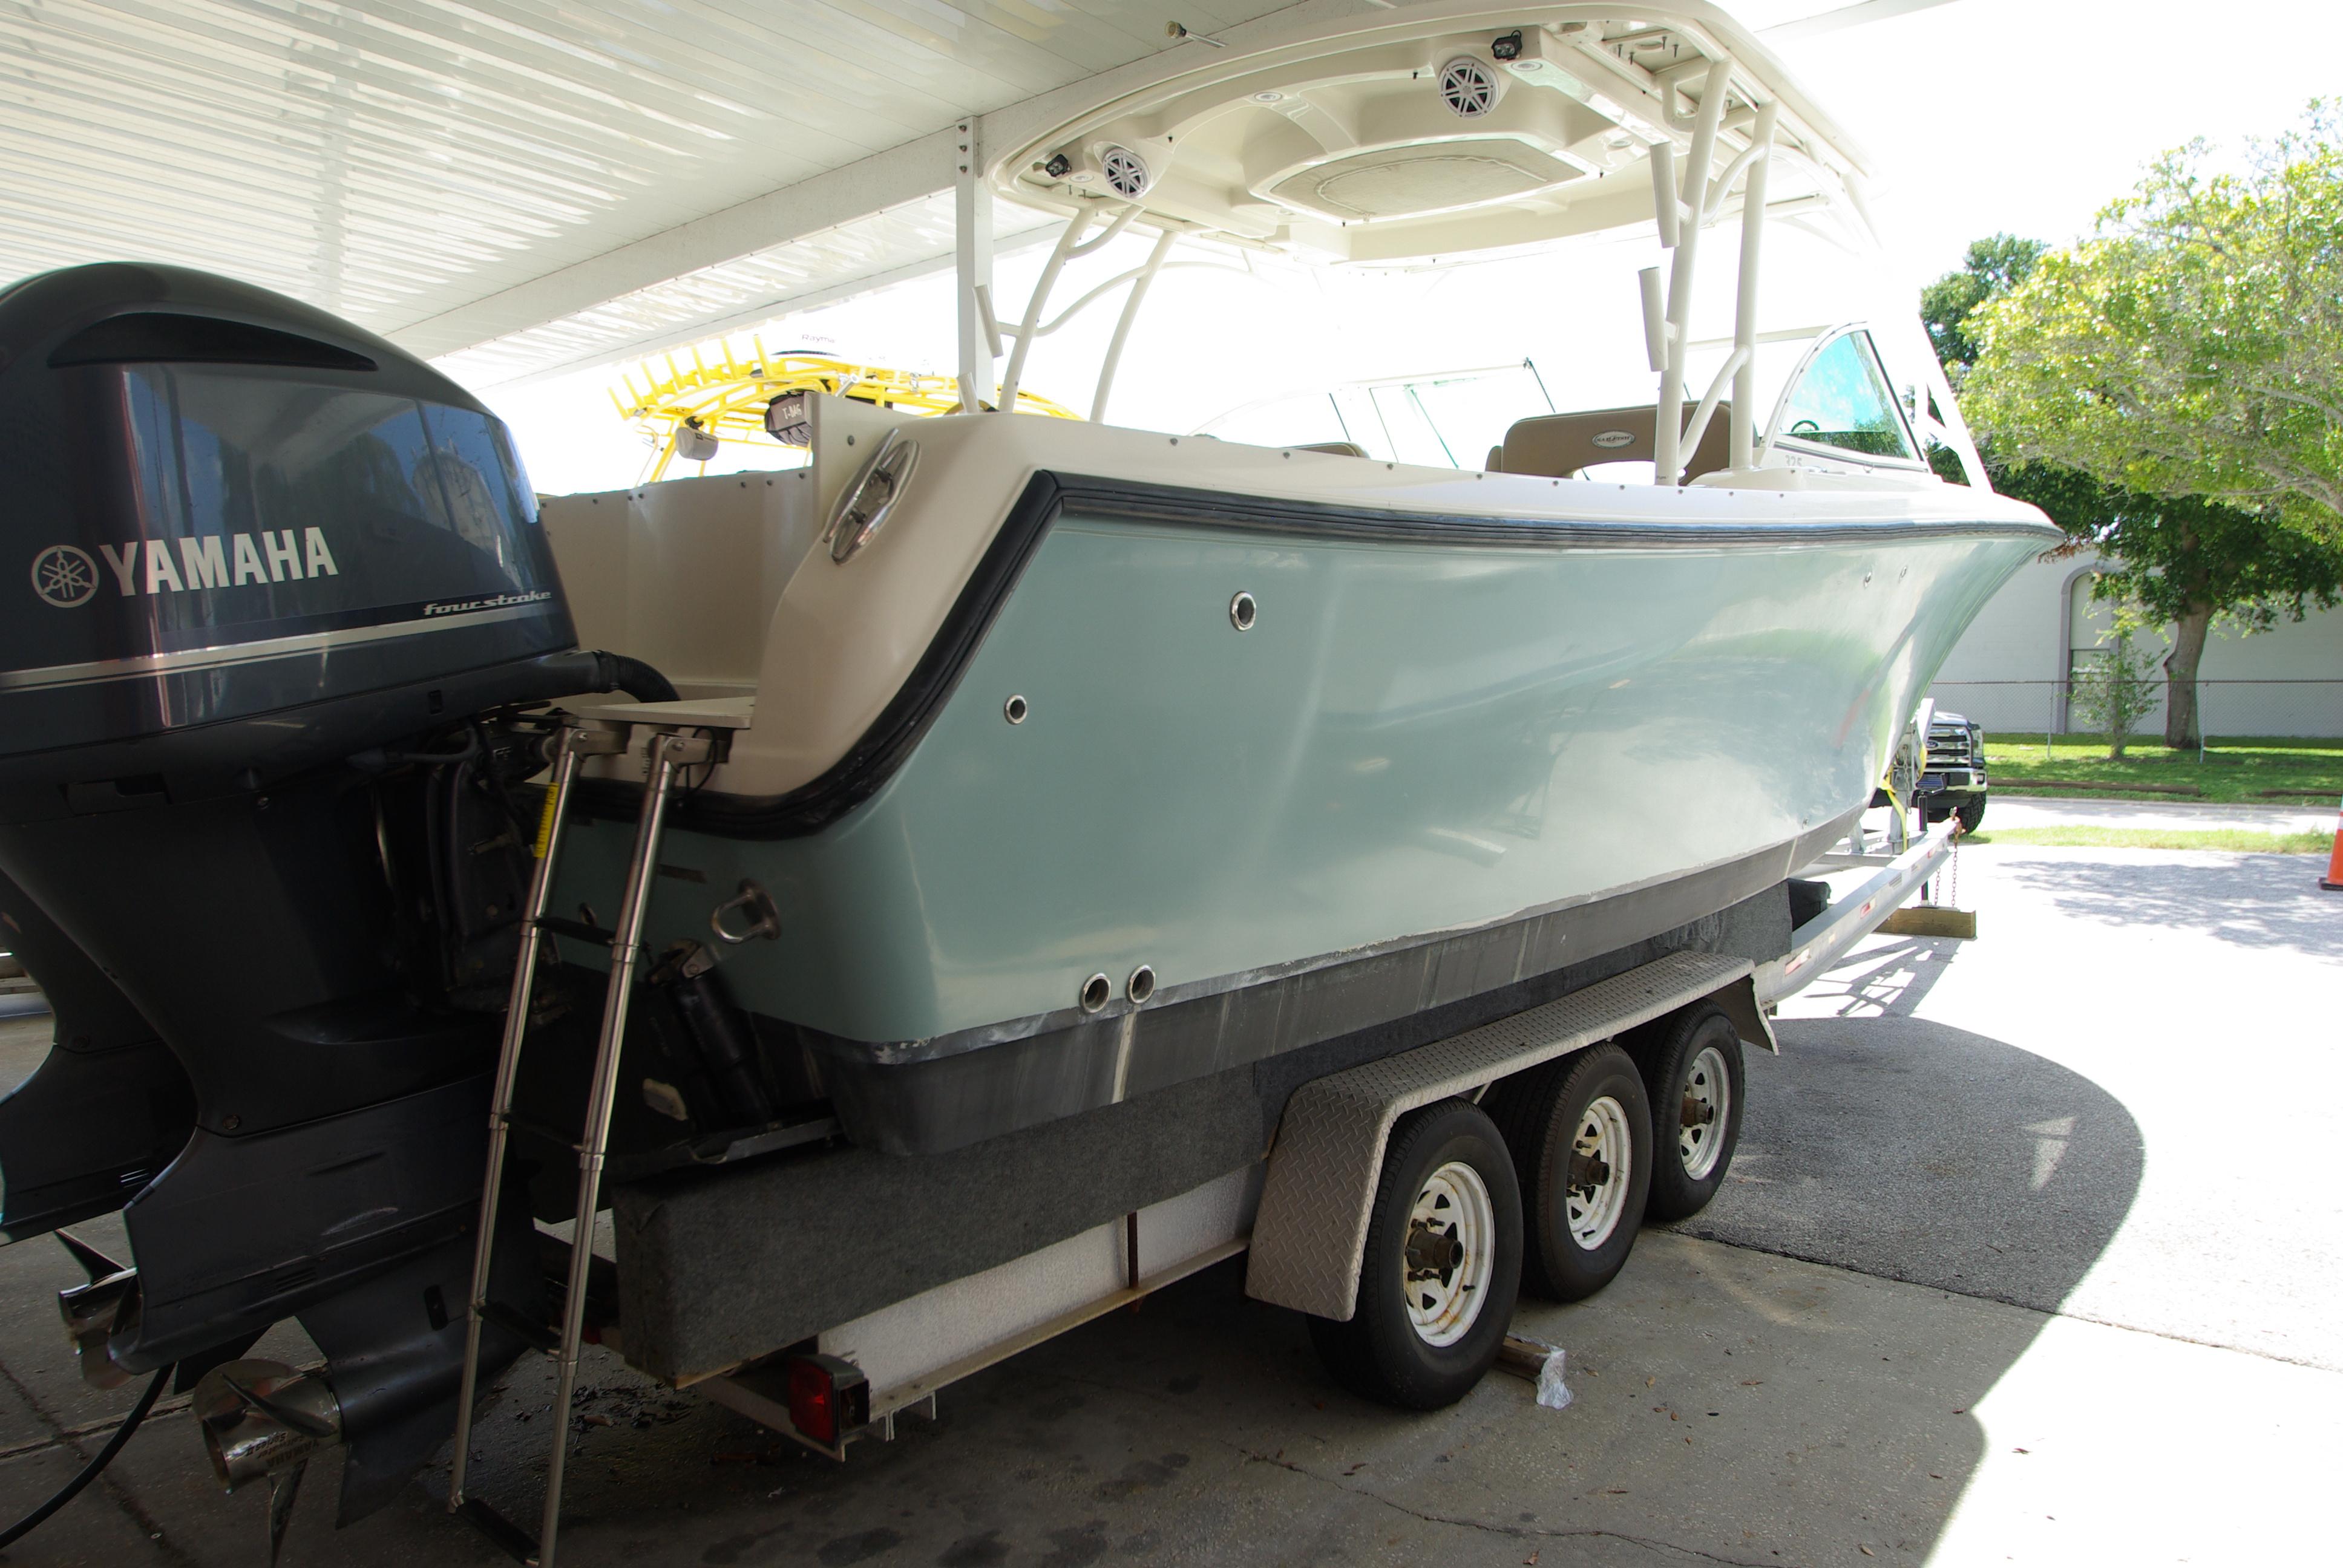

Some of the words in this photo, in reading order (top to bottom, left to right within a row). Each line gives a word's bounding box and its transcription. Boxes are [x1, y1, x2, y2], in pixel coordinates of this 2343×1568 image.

[1784, 454, 1803, 466] 325
[99, 527, 339, 596] YAMAHA
[266, 1440, 320, 1468] YAMAHA
